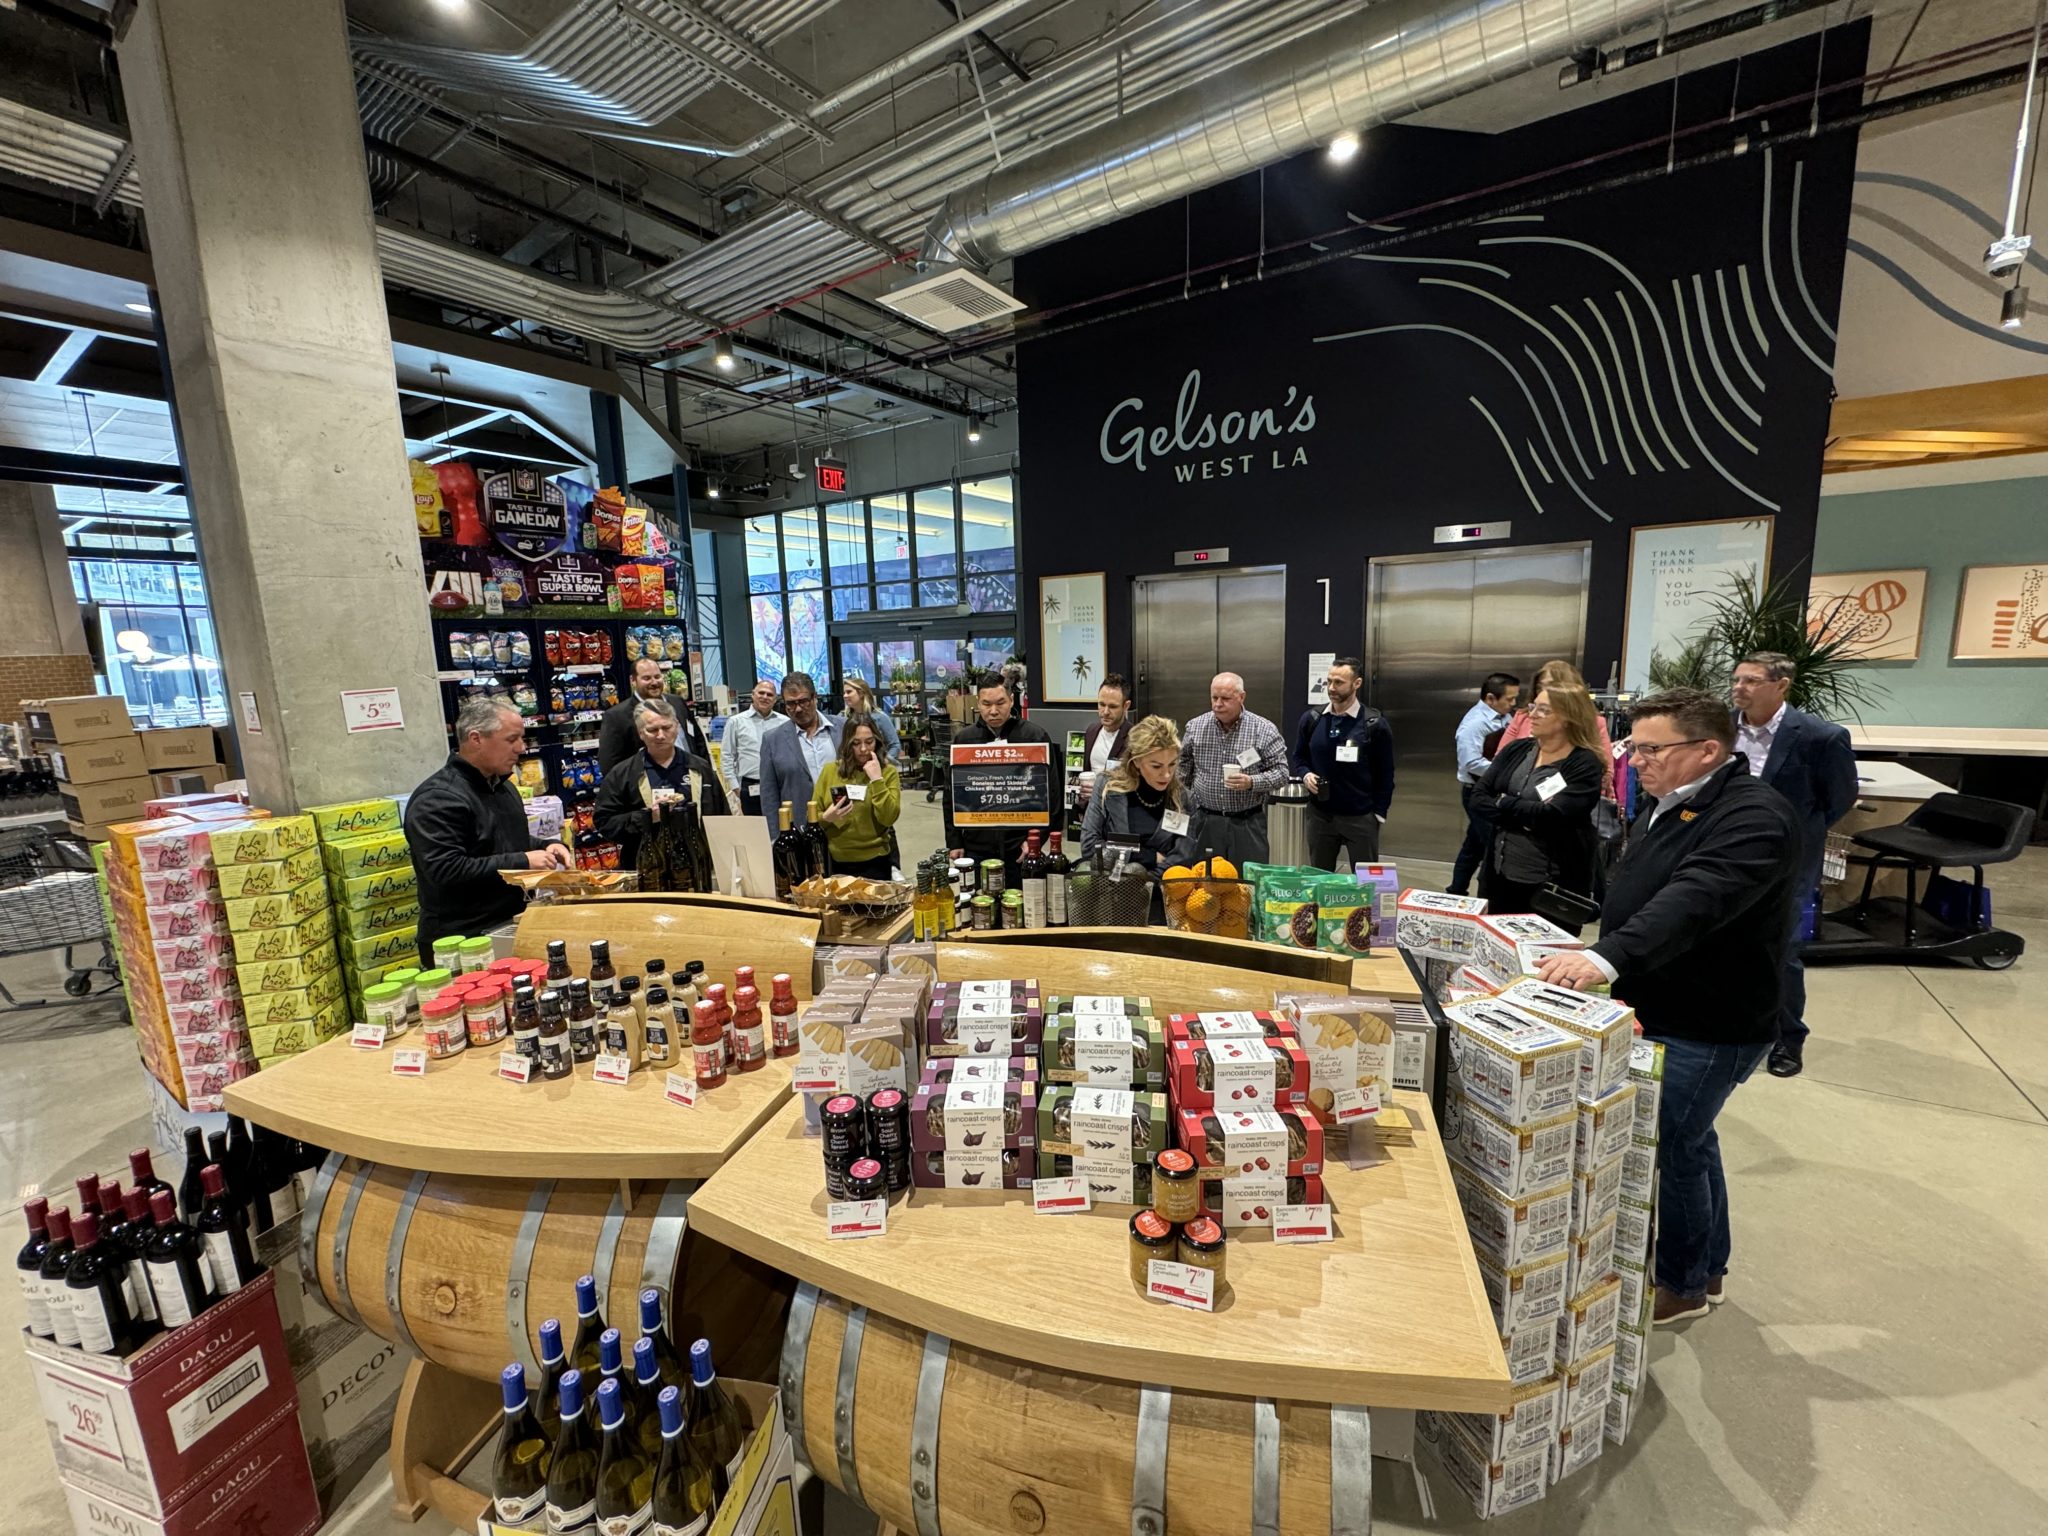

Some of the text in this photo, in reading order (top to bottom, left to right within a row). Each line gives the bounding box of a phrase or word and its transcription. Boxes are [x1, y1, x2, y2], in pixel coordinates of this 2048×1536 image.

[1100, 369, 1316, 471] Gelson's
[1175, 446, 1308, 483] WEST LA
[519, 478, 534, 488] NFL
[823, 469, 843, 489] EXIT
[506, 503, 534, 512] TASTE
[495, 510, 560, 528] GAMEDAY
[594, 508, 622, 523] Doritos
[1651, 549, 1696, 558] THANK
[1651, 558, 1695, 567] THANK
[1650, 567, 1694, 576] THANK
[550, 573, 582, 584] TASTE
[542, 583, 603, 593] SUPER BOWL
[1665, 581, 1693, 589] YOU
[1316, 578, 1330, 625] 1
[974, 749, 1001, 758] SAVE
[1270, 887, 1302, 899] FILLO'S
[1324, 894, 1357, 904] FILLO'S
[990, 1023, 1009, 1031] crisps
[1110, 1048, 1131, 1056] crisps
[1217, 1068, 1273, 1077] raincoast crisps
[946, 1114, 1001, 1123] raincoast crisps
[1073, 1120, 1130, 1132] raincoast crisps
[1227, 1138, 1286, 1149] raincoast crisps
[978, 1155, 1000, 1163] crisps
[1075, 1164, 1131, 1175] raincoast crisps
[1225, 1188, 1285, 1198] raincoast crisps
[179, 1328, 234, 1373] DAOU
[321, 1343, 397, 1412] DECOY
[211, 1455, 262, 1504] DAOU
